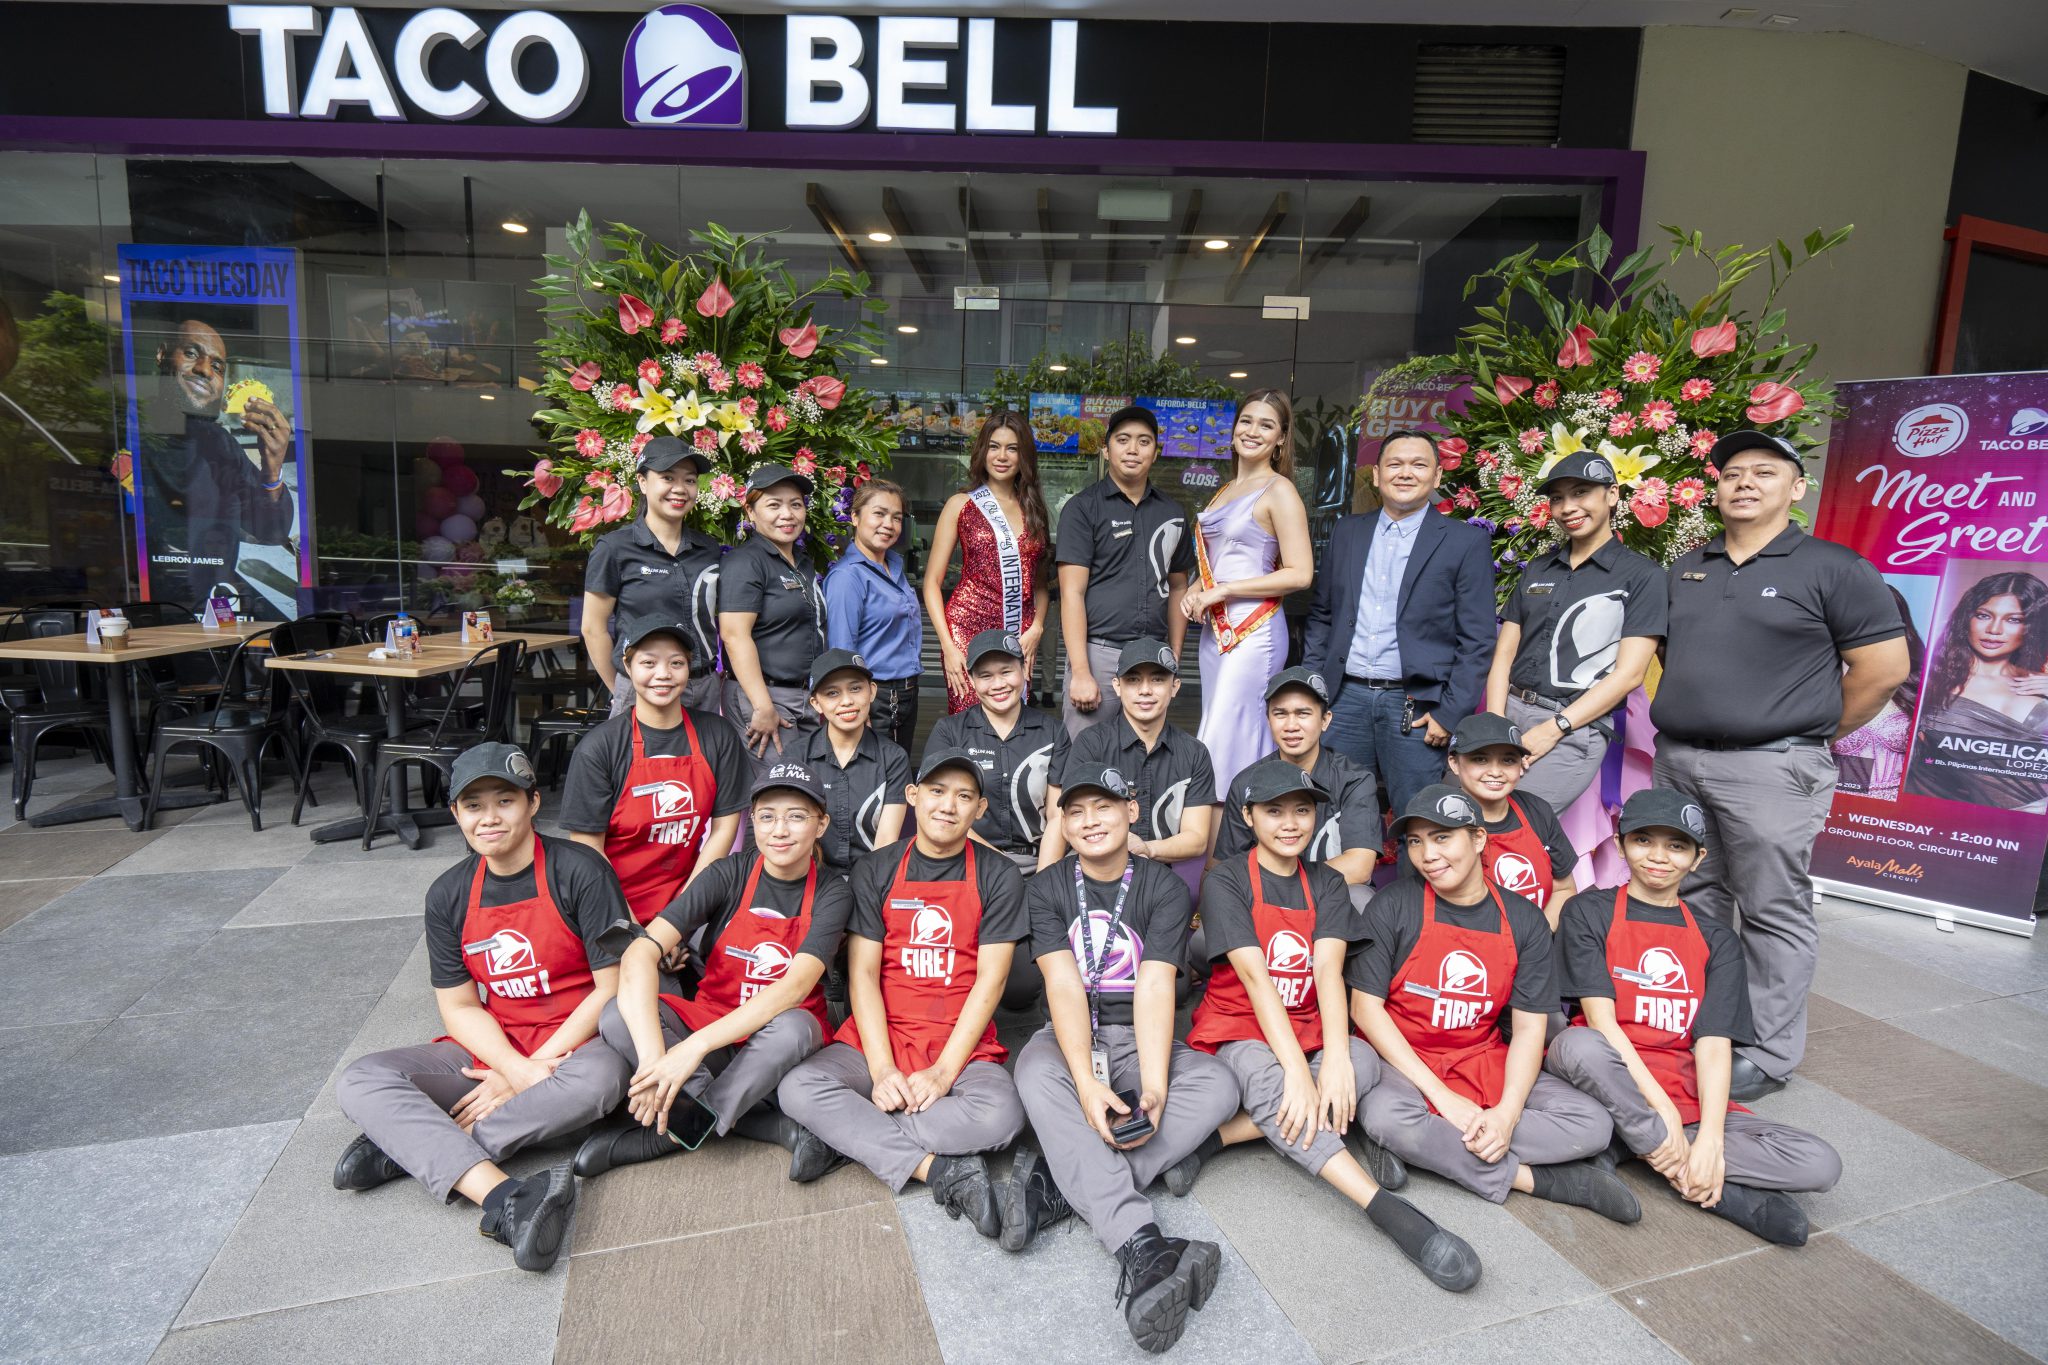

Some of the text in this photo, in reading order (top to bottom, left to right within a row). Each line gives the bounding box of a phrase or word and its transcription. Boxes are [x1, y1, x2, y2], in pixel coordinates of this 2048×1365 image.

[228, 5, 1119, 136] TACO BELL
[125, 258, 289, 298] TACO TUESDAY
[1084, 405, 1104, 413] GET
[1085, 397, 1127, 407] BUY ONE
[1155, 399, 1207, 410] AFFORDA-BELLS
[1369, 399, 1427, 417] BUY
[1906, 425, 1950, 441] Pizza
[1912, 434, 1947, 449] Hut
[1979, 439, 2048, 451] TACO BE
[1182, 472, 1220, 488] CLOSE
[1855, 464, 2037, 514] Meet AND
[974, 488, 991, 500] 2023
[1886, 511, 2048, 566] Greet
[152, 555, 224, 565] LEBRON JAMES
[1002, 554, 1021, 640] INTERNATIO
[1937, 735, 2048, 762] ANGELICA
[786, 763, 804, 772] LIVE
[1935, 759, 2048, 780] Bb. Pilipinas International 2023
[2006, 759, 2048, 773] LOPEZ
[1843, 782, 1861, 790] 2023
[647, 815, 701, 848] FIRE!
[1848, 812, 1934, 836] WEDNESDAY
[1950, 831, 1993, 847] 12:00
[1996, 838, 2020, 851] NN
[1828, 826, 1874, 841] GROUND
[1918, 843, 1965, 858] CIRCUIT
[1966, 851, 1999, 865] LANE
[1882, 872, 1919, 884] CIRCUIT
[901, 947, 956, 986] FIRE!
[1431, 997, 1494, 1030] FIRE!
[1635, 995, 1699, 1041] FIRE!
